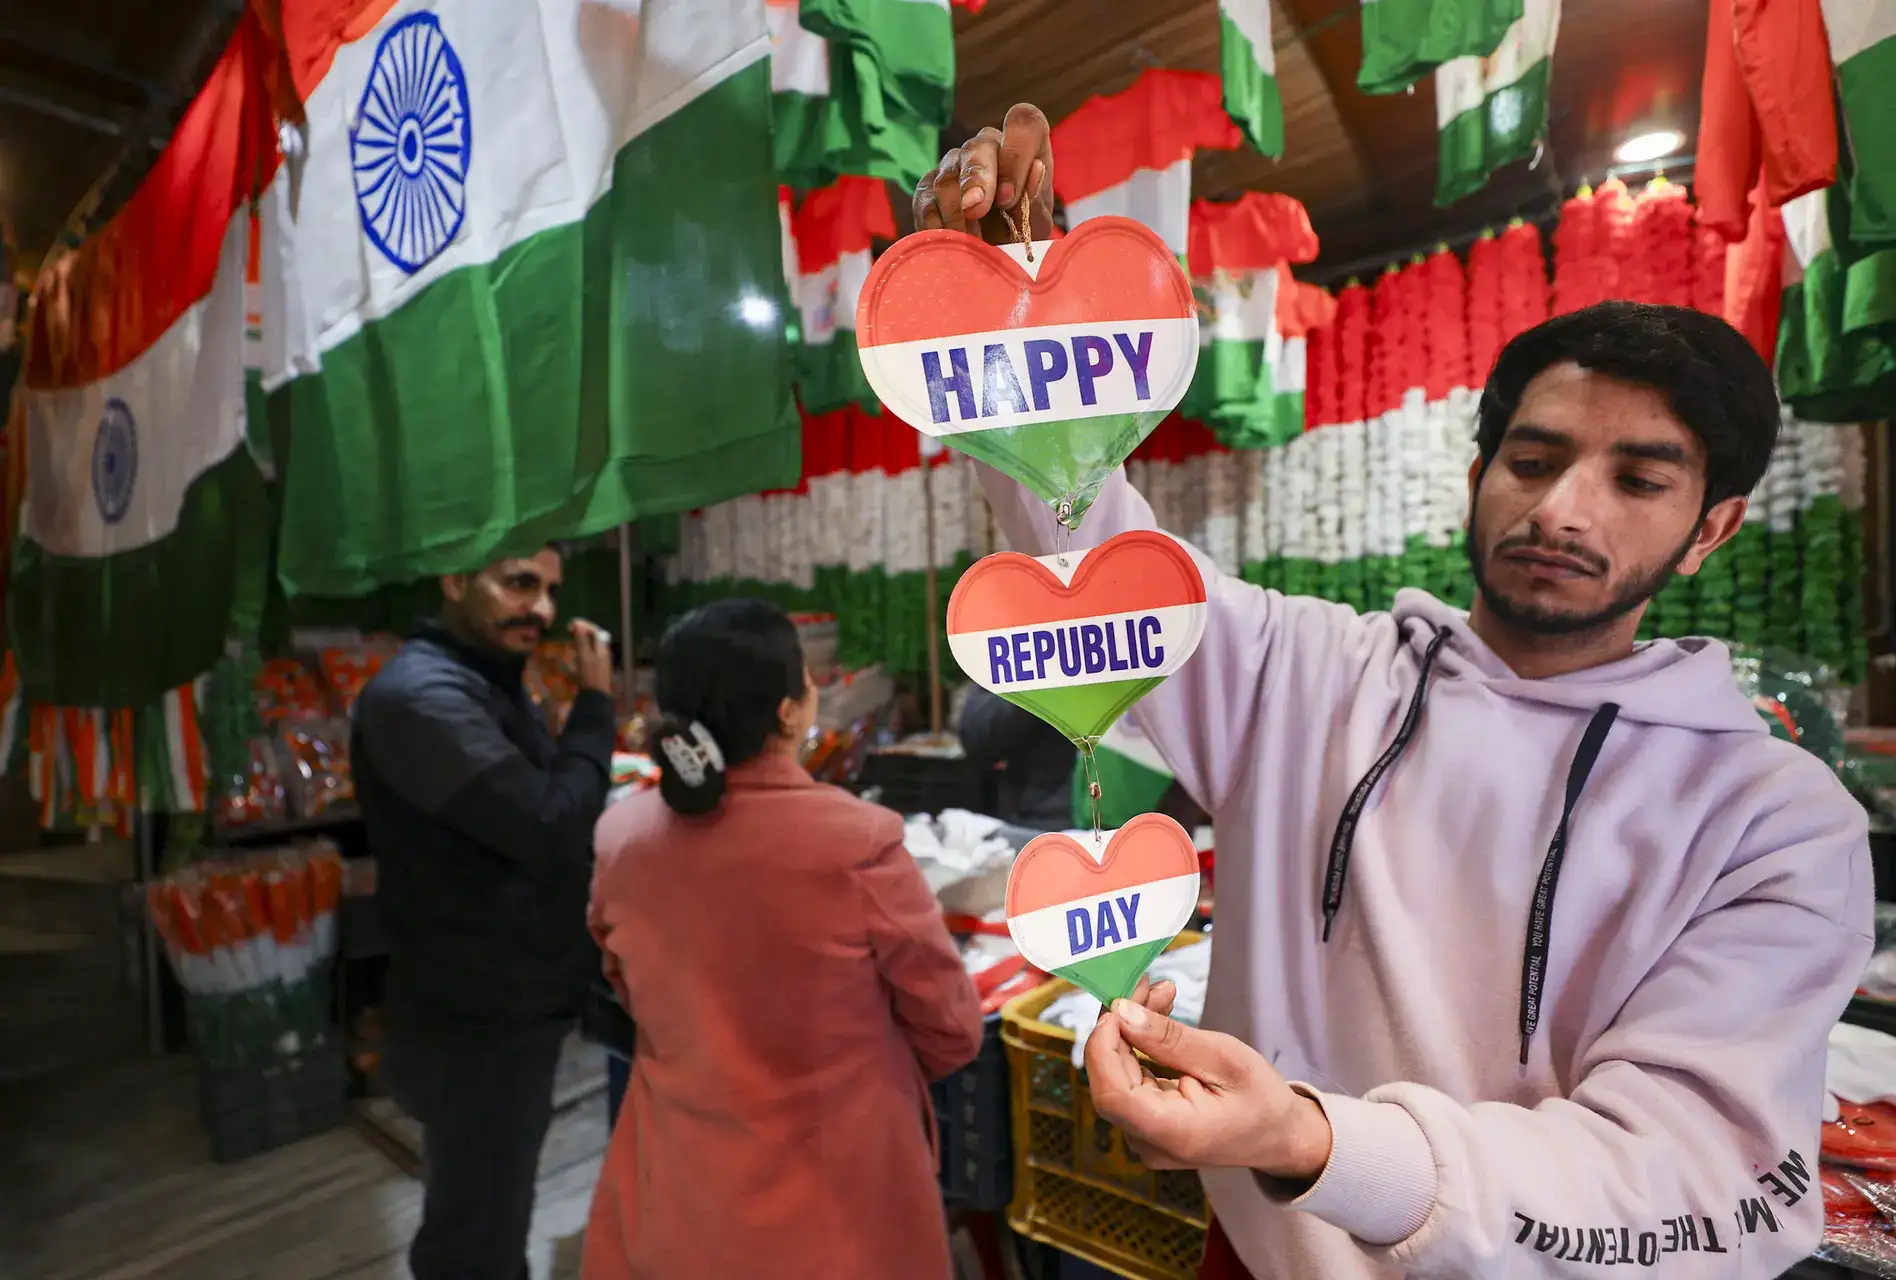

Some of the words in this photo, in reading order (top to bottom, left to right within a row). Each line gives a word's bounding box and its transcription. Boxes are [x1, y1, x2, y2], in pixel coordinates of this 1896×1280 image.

[921, 332, 1154, 424] HAPPY
[987, 616, 1165, 685] REPUBLIC
[1542, 848, 1558, 884] POTENTIAL
[1536, 886, 1548, 909] GREAT
[1066, 893, 1140, 956] DAY
[1532, 930, 1543, 947] YOU
[1534, 910, 1545, 930] HAVE
[1528, 956, 1541, 996] POTENTIAL
[1526, 996, 1537, 1020] GREAT
[1757, 1148, 1811, 1208] WE
[1514, 1212, 1659, 1267] OTENTIAL
[1661, 1214, 1727, 1253] THE
